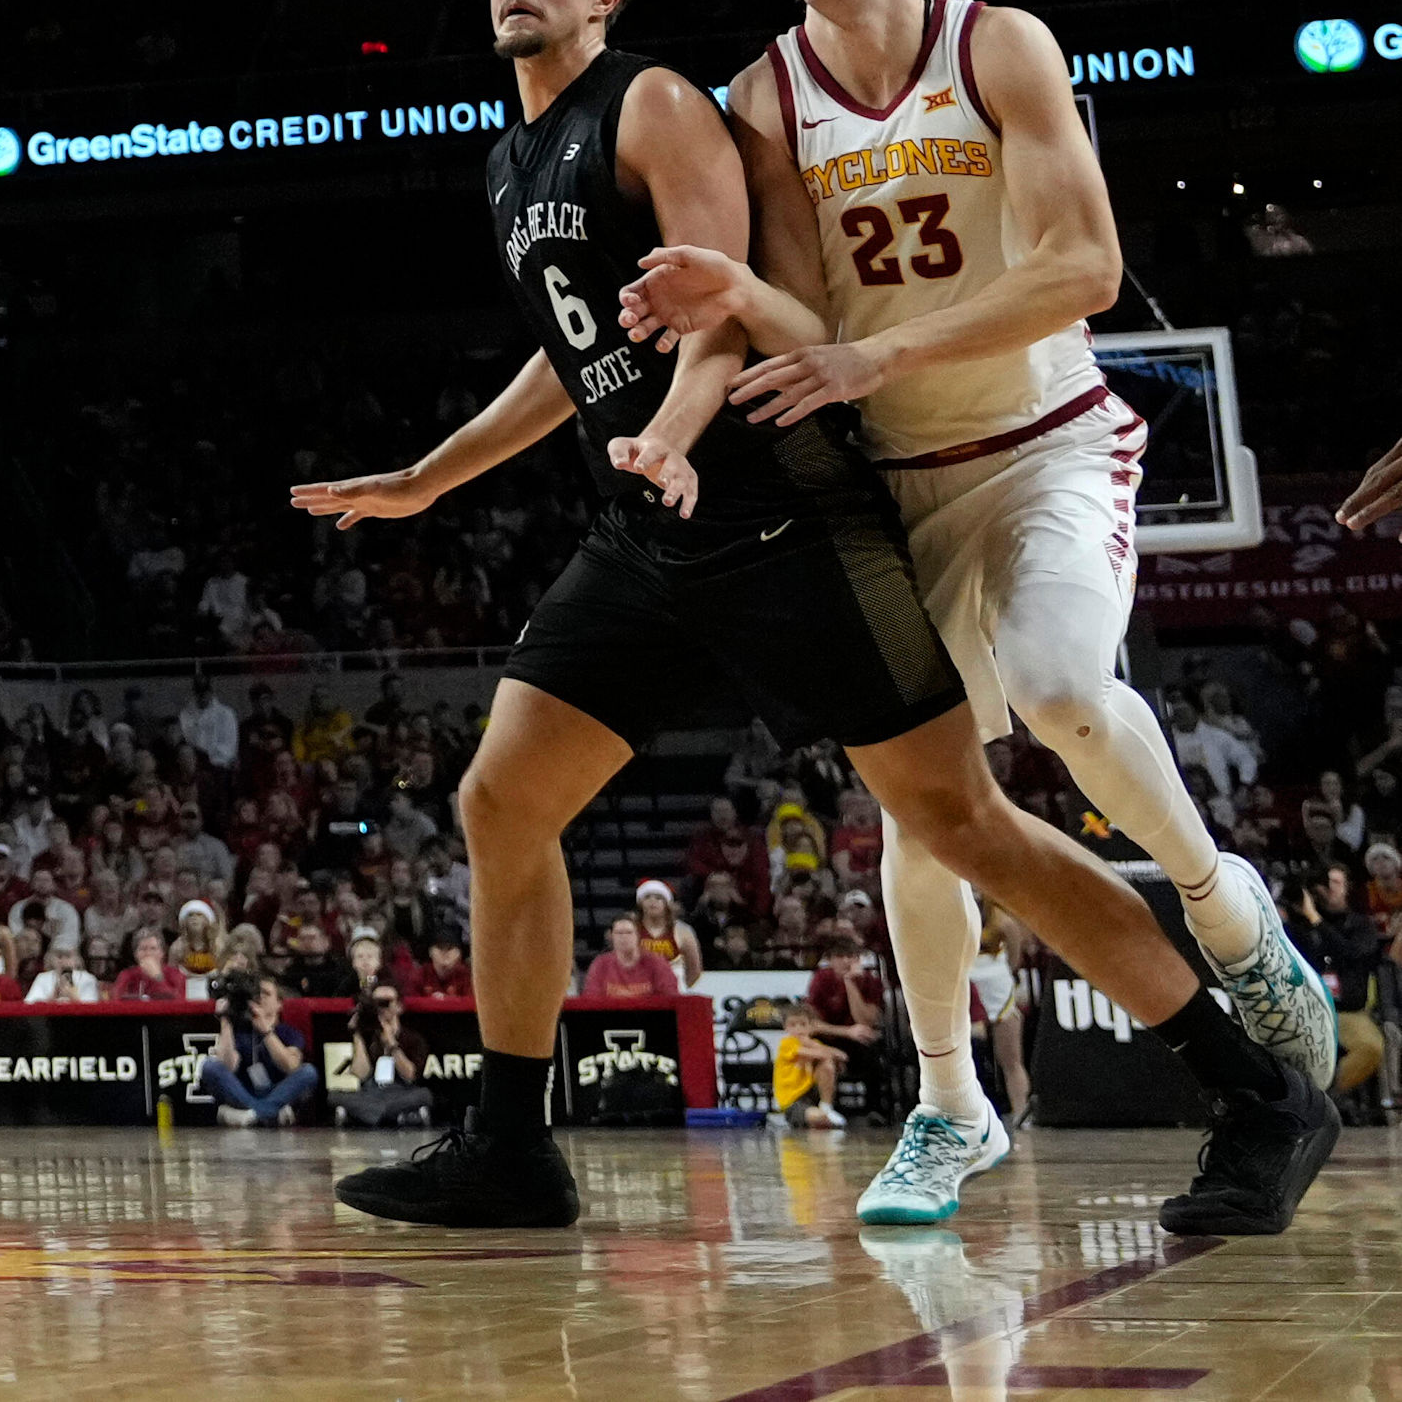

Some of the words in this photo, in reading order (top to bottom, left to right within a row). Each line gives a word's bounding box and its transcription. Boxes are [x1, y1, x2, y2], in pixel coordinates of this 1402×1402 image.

[27, 120, 224, 166] GreenState
[229, 110, 368, 150] CREDIT
[380, 99, 504, 139] UNION
[800, 138, 993, 207] CYCLONES
[526, 200, 588, 242] BEACH
[840, 193, 964, 287] 23
[543, 264, 598, 352] 6
